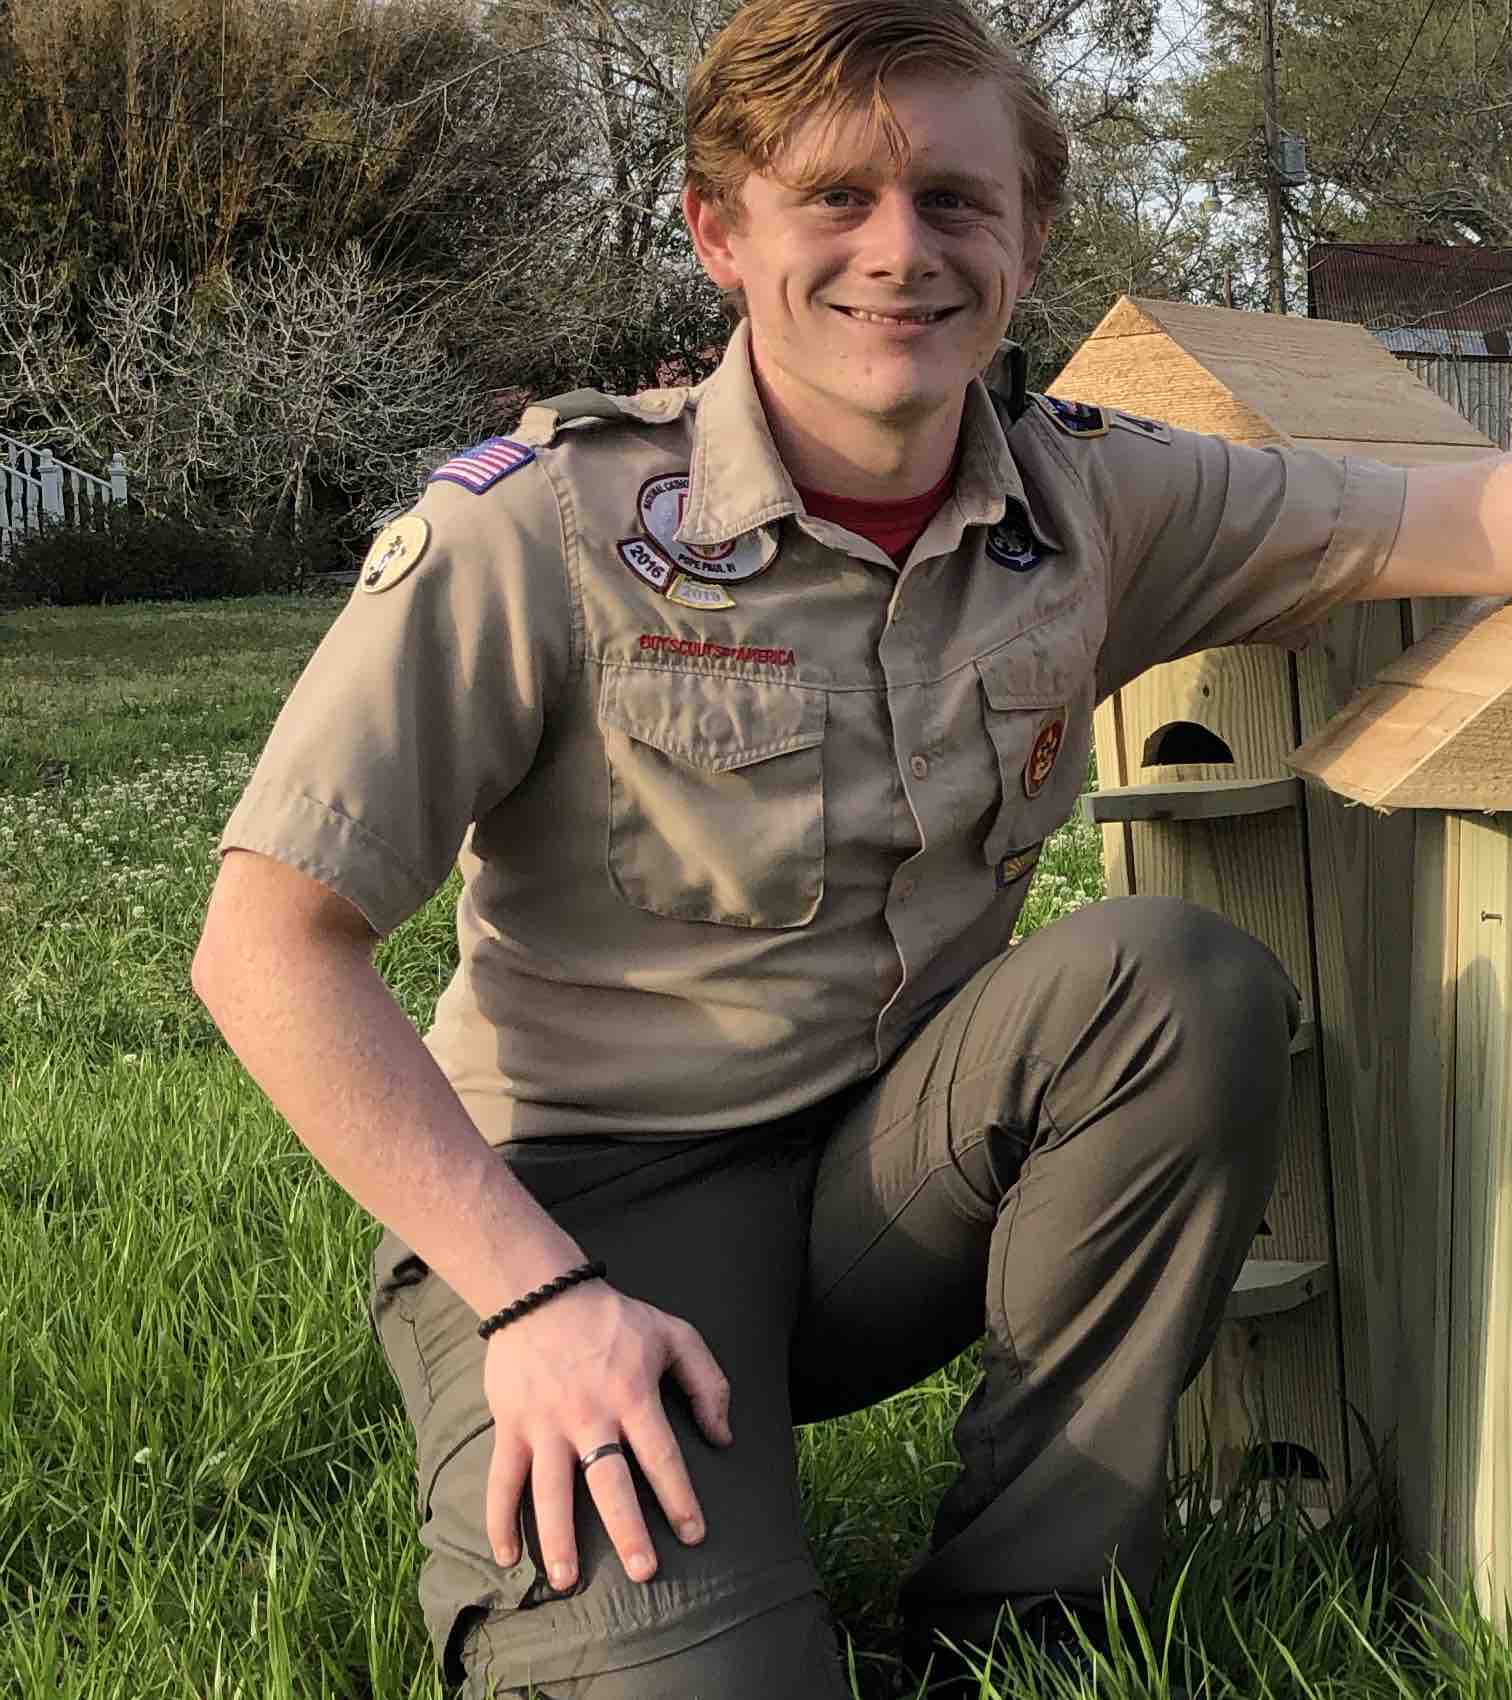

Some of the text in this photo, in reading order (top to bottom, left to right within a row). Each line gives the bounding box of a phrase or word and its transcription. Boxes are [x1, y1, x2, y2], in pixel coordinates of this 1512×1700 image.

[630, 545, 665, 578] 2016
[679, 553, 701, 570] POPE
[703, 562, 726, 573] PAUL
[639, 634, 671, 651] BOY
[670, 639, 721, 657] SCOUTS
[736, 647, 796, 667] AMERICA
